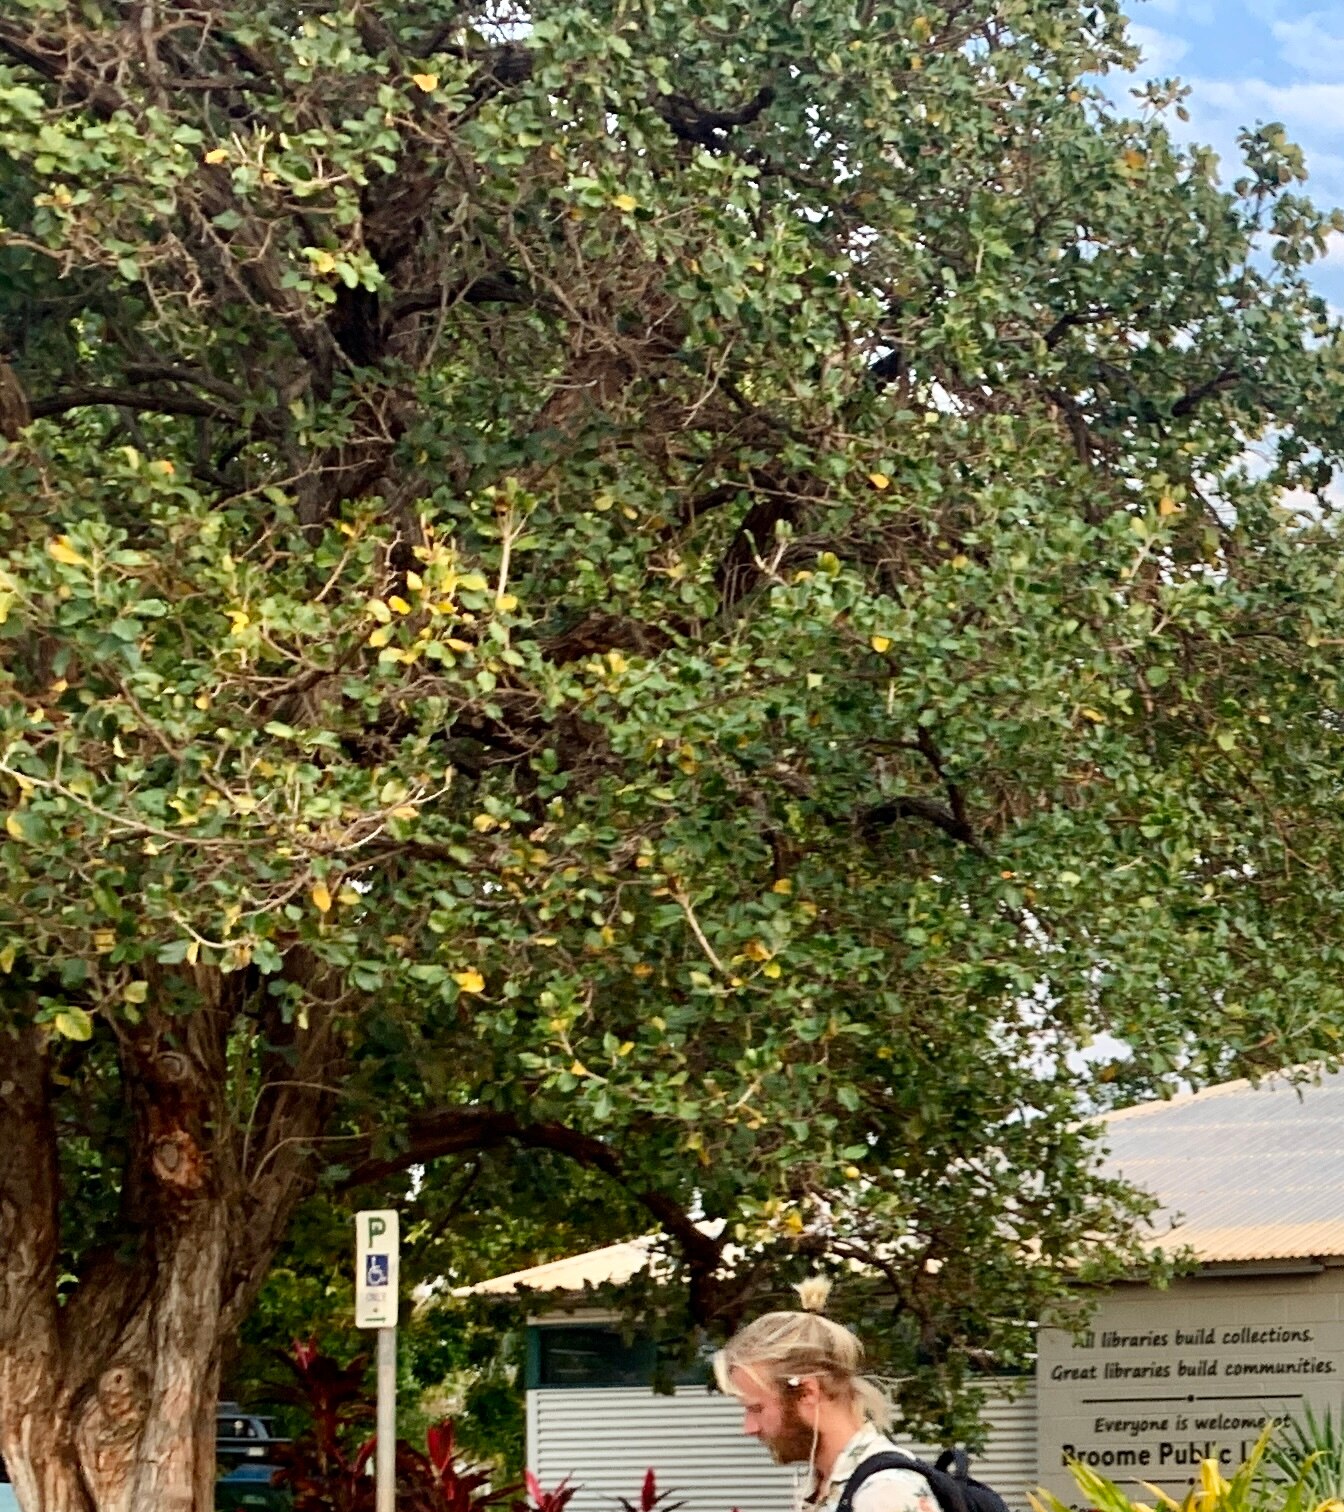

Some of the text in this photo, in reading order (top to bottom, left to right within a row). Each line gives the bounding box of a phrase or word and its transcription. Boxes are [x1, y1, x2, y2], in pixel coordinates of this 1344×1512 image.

[368, 1217, 386, 1248] P
[1101, 1329, 1169, 1348] libraries
[1175, 1327, 1216, 1346] build
[1222, 1326, 1314, 1345] collections.
[1051, 1356, 1337, 1382] Great libraries build communities.
[1094, 1416, 1168, 1437] Everyone
[1175, 1414, 1188, 1431] is
[1195, 1413, 1266, 1431] welcome
[1062, 1444, 1151, 1467] Broome
[1160, 1441, 1231, 1465] Publc
